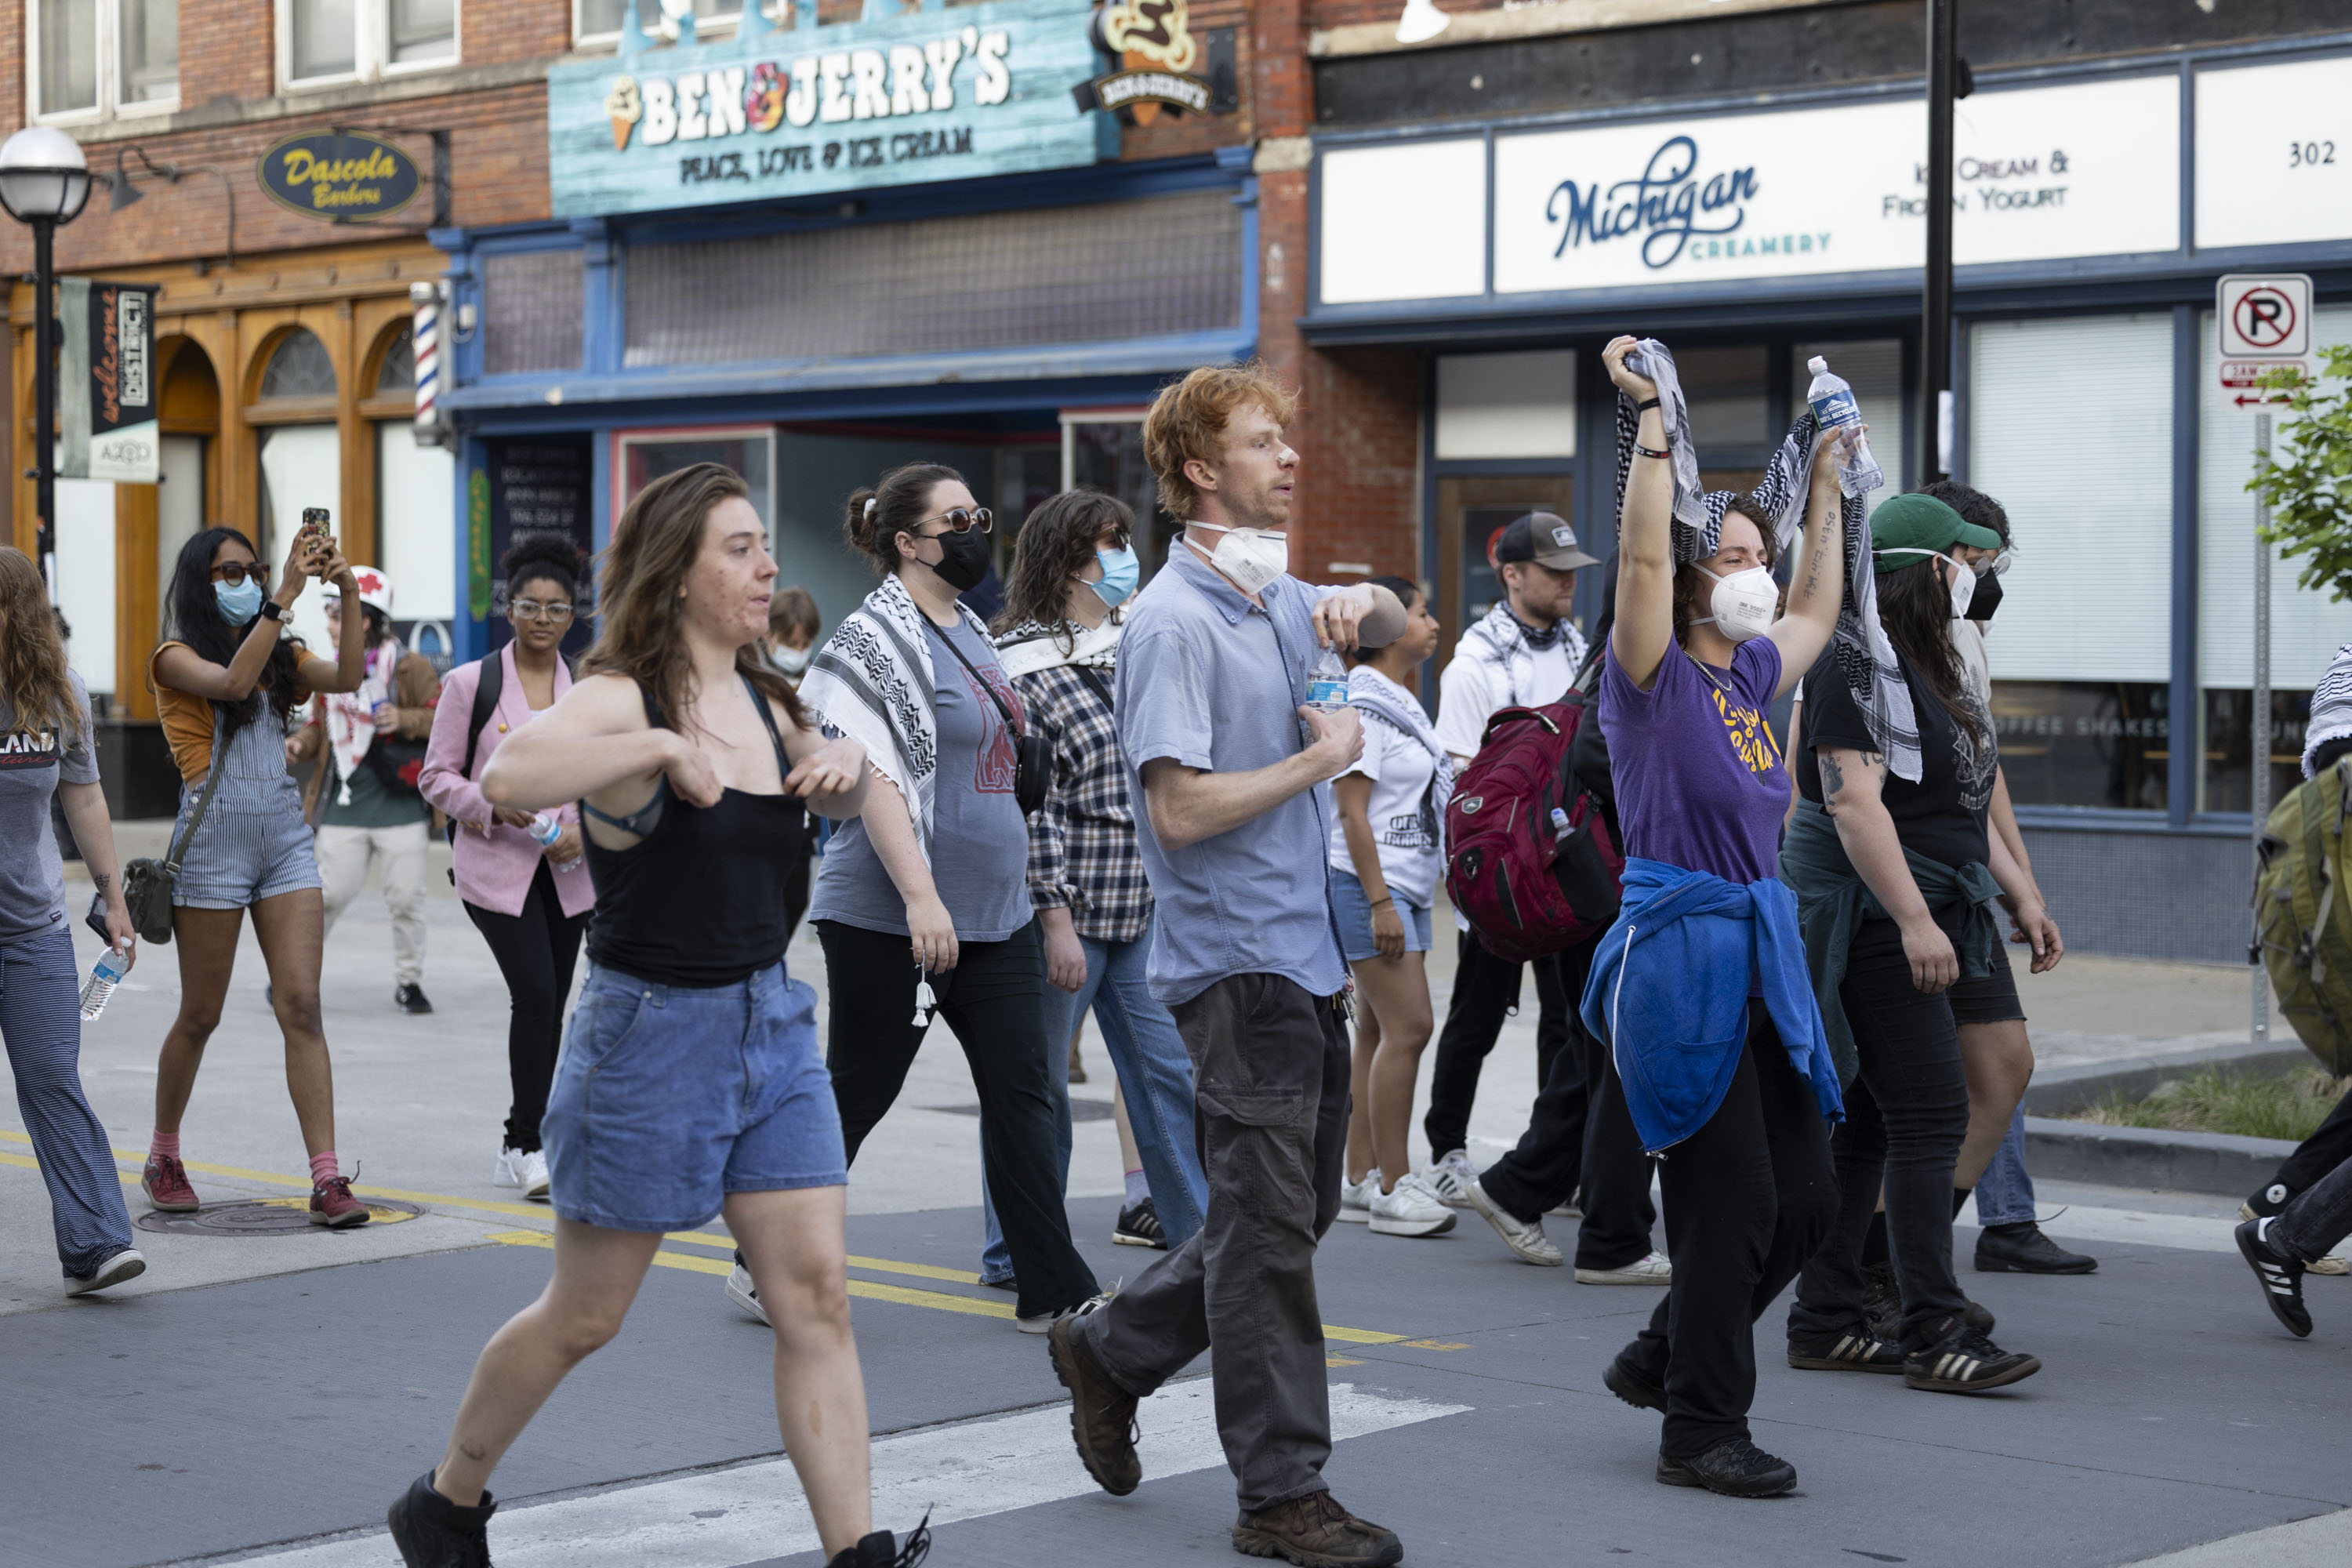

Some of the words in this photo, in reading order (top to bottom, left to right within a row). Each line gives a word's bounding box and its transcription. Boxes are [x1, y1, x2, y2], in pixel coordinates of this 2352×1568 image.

[283, 146, 398, 187] Dascola
[680, 151, 750, 185] PEACE,
[758, 145, 814, 177] LOVE
[822, 141, 843, 169] &
[848, 136, 884, 168] ICE
[891, 126, 974, 162] CREAM
[2049, 149, 2071, 174] &
[2288, 140, 2335, 169] 302
[311, 181, 382, 209] Barbers
[1546, 135, 1759, 269] Michigan
[1882, 193, 1967, 218] FRON
[1690, 231, 1831, 260] CREAMERY
[92, 285, 120, 424] welcome
[124, 299, 143, 399] DISTRICT
